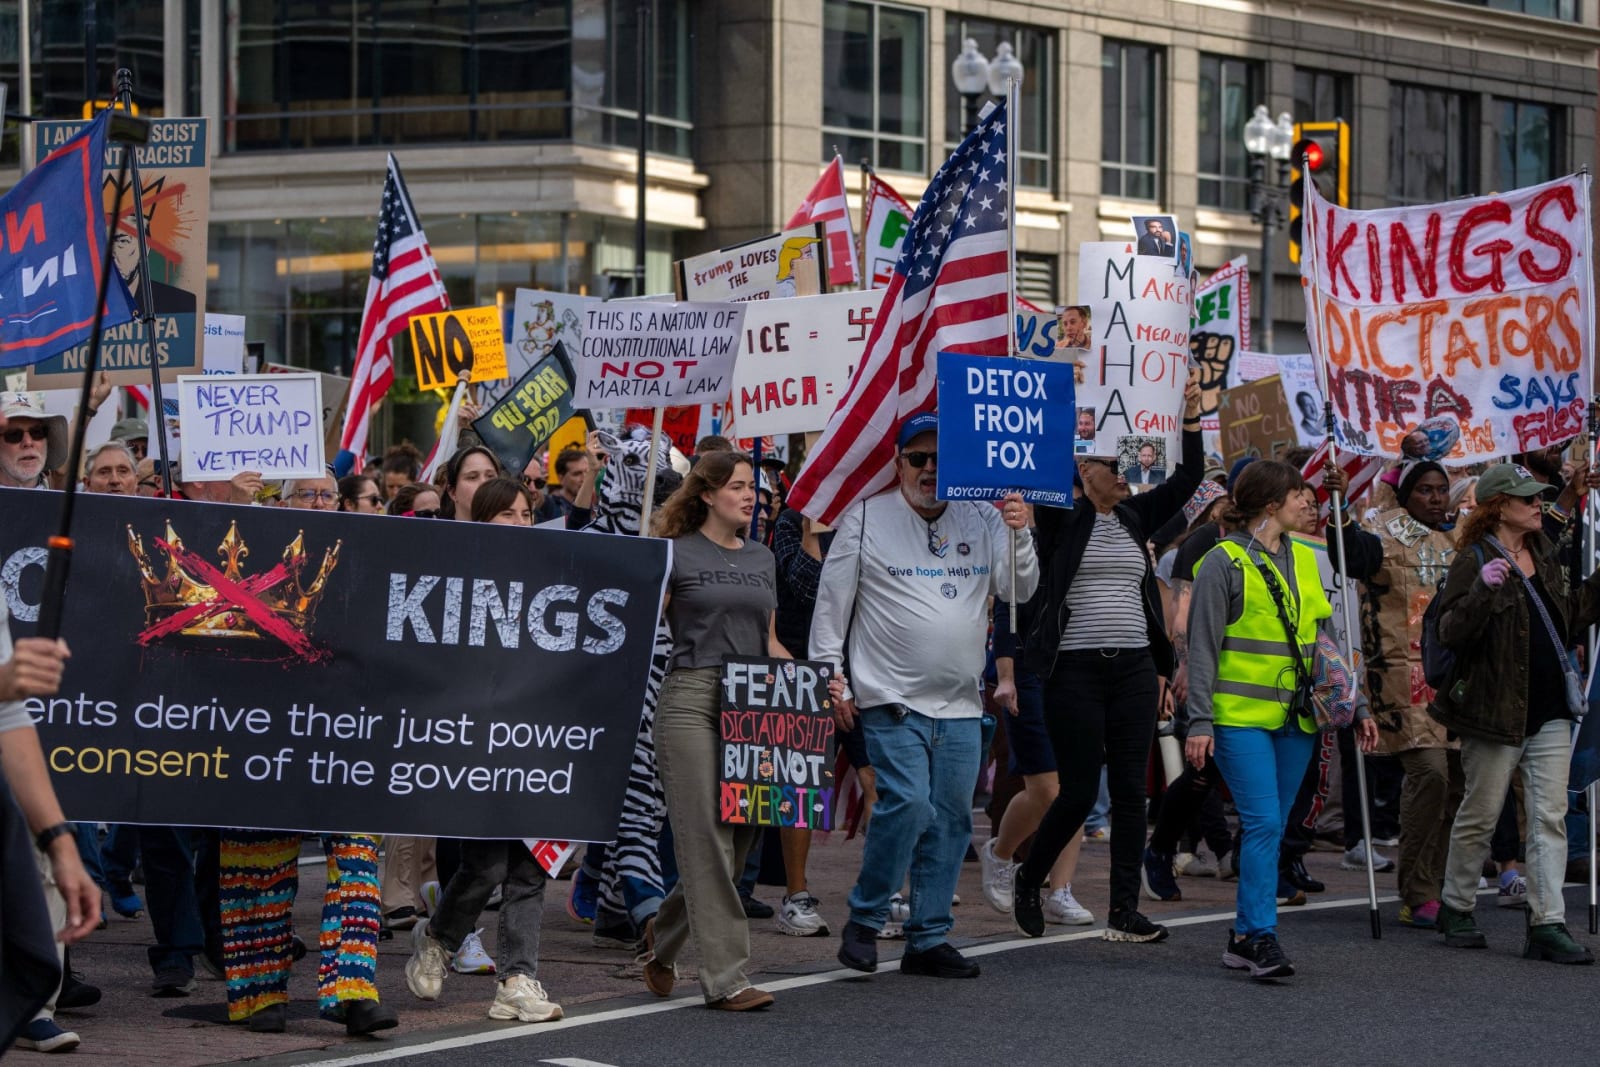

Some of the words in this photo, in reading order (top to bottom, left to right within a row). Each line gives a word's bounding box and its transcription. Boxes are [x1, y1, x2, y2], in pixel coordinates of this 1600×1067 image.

[44, 127, 49, 145] I
[152, 123, 199, 142] SCIST
[136, 145, 193, 164] RACIST
[1327, 185, 1577, 304] KINGS
[694, 260, 734, 286] trump
[740, 249, 777, 268] LOVES
[728, 271, 749, 289] THE
[104, 317, 179, 341] ANTFA
[203, 324, 223, 336] cist
[587, 311, 624, 331] THIS
[630, 311, 643, 331] IS
[647, 313, 658, 331] A
[660, 311, 708, 332] NATION
[713, 311, 738, 329] OF
[1325, 286, 1582, 380] DICTATORS
[413, 315, 474, 385] NO
[582, 336, 696, 358] CONSTITUTIONAL
[702, 335, 733, 357] LAW
[747, 322, 790, 354] ICE
[101, 341, 168, 368] KINGS
[601, 360, 698, 379] NOT
[197, 384, 280, 409] NEVER
[588, 379, 673, 399] MARTIAL
[686, 376, 723, 394] LAW
[741, 376, 818, 416] MAGA
[967, 367, 1048, 400] DETOX
[1327, 362, 1473, 432] NTIFA
[1492, 372, 1579, 413] SAYS
[205, 407, 311, 437] TRUMP
[974, 403, 1044, 435] FROM
[986, 440, 1036, 470] FOX
[947, 486, 993, 498] BOYCOTT
[887, 566, 913, 577] Give
[947, 567, 970, 579] Help
[386, 573, 631, 655] KINGS
[727, 662, 820, 712] FEAR
[24, 692, 117, 727] ents
[134, 695, 271, 734] derive
[288, 703, 382, 740] their
[393, 708, 474, 748] just
[488, 721, 605, 754] power
[721, 711, 835, 752] DICTATORSHIP
[50, 746, 229, 778] consent
[244, 748, 294, 781] of
[308, 751, 375, 786] the
[388, 762, 573, 795] governed
[724, 744, 766, 781] BUT
[773, 746, 825, 786] NOT
[720, 781, 834, 830] DIVERSITY
